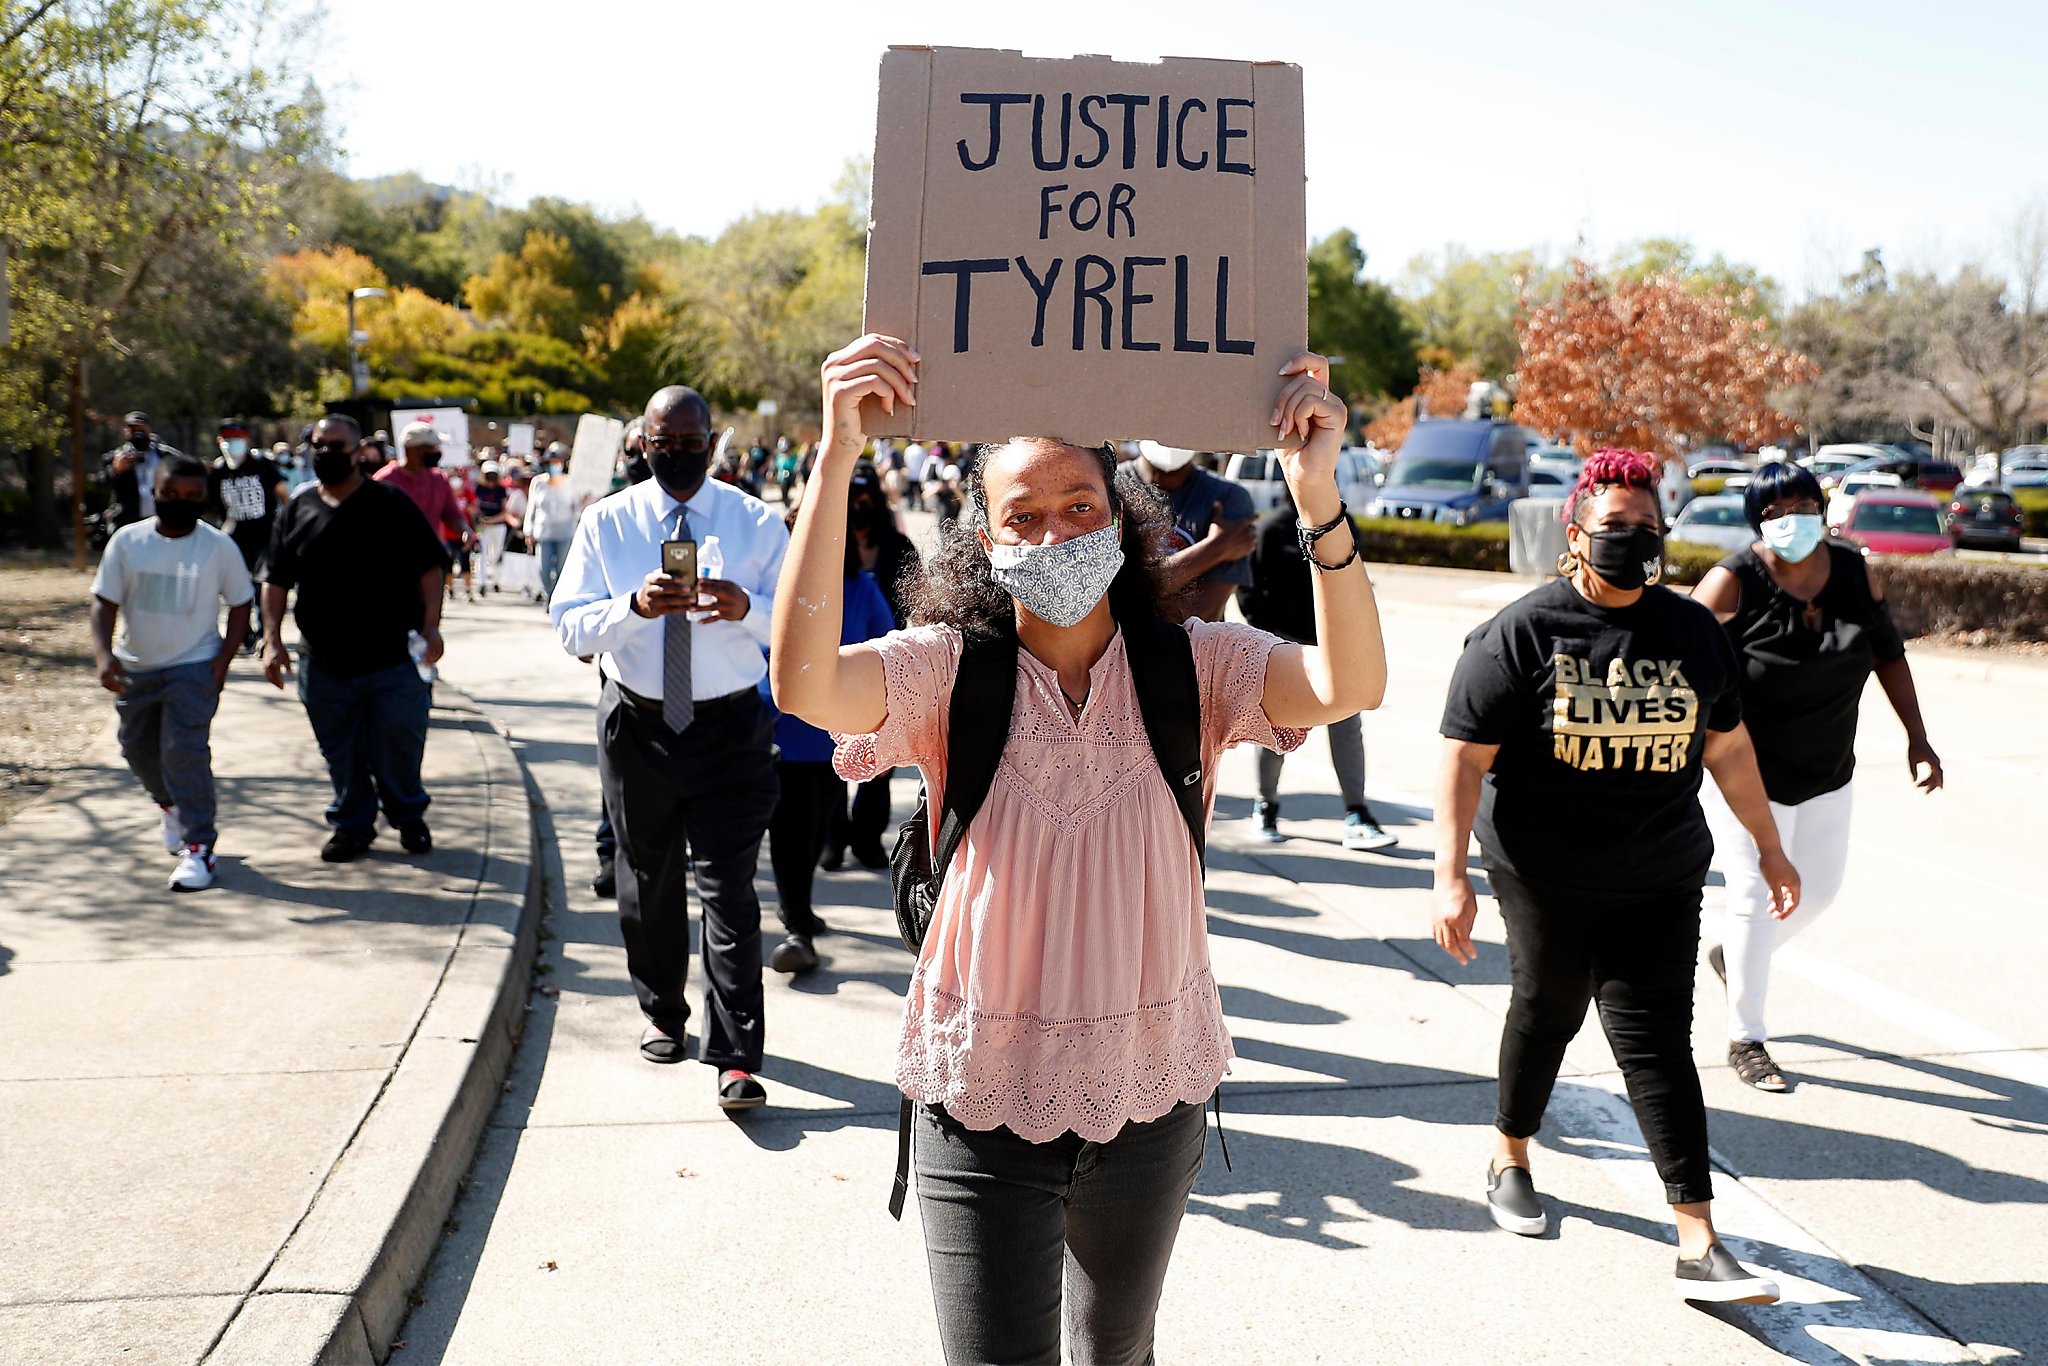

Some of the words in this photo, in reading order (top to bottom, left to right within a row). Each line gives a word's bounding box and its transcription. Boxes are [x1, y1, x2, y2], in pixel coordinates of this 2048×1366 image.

[956, 91, 1256, 176] JUSTICE
[1039, 182, 1136, 240] FOR
[921, 253, 1256, 356] TYRELL
[1555, 654, 1689, 687] BLACK
[1568, 697, 1687, 724] LIVES
[1554, 734, 1691, 772] MATTER
